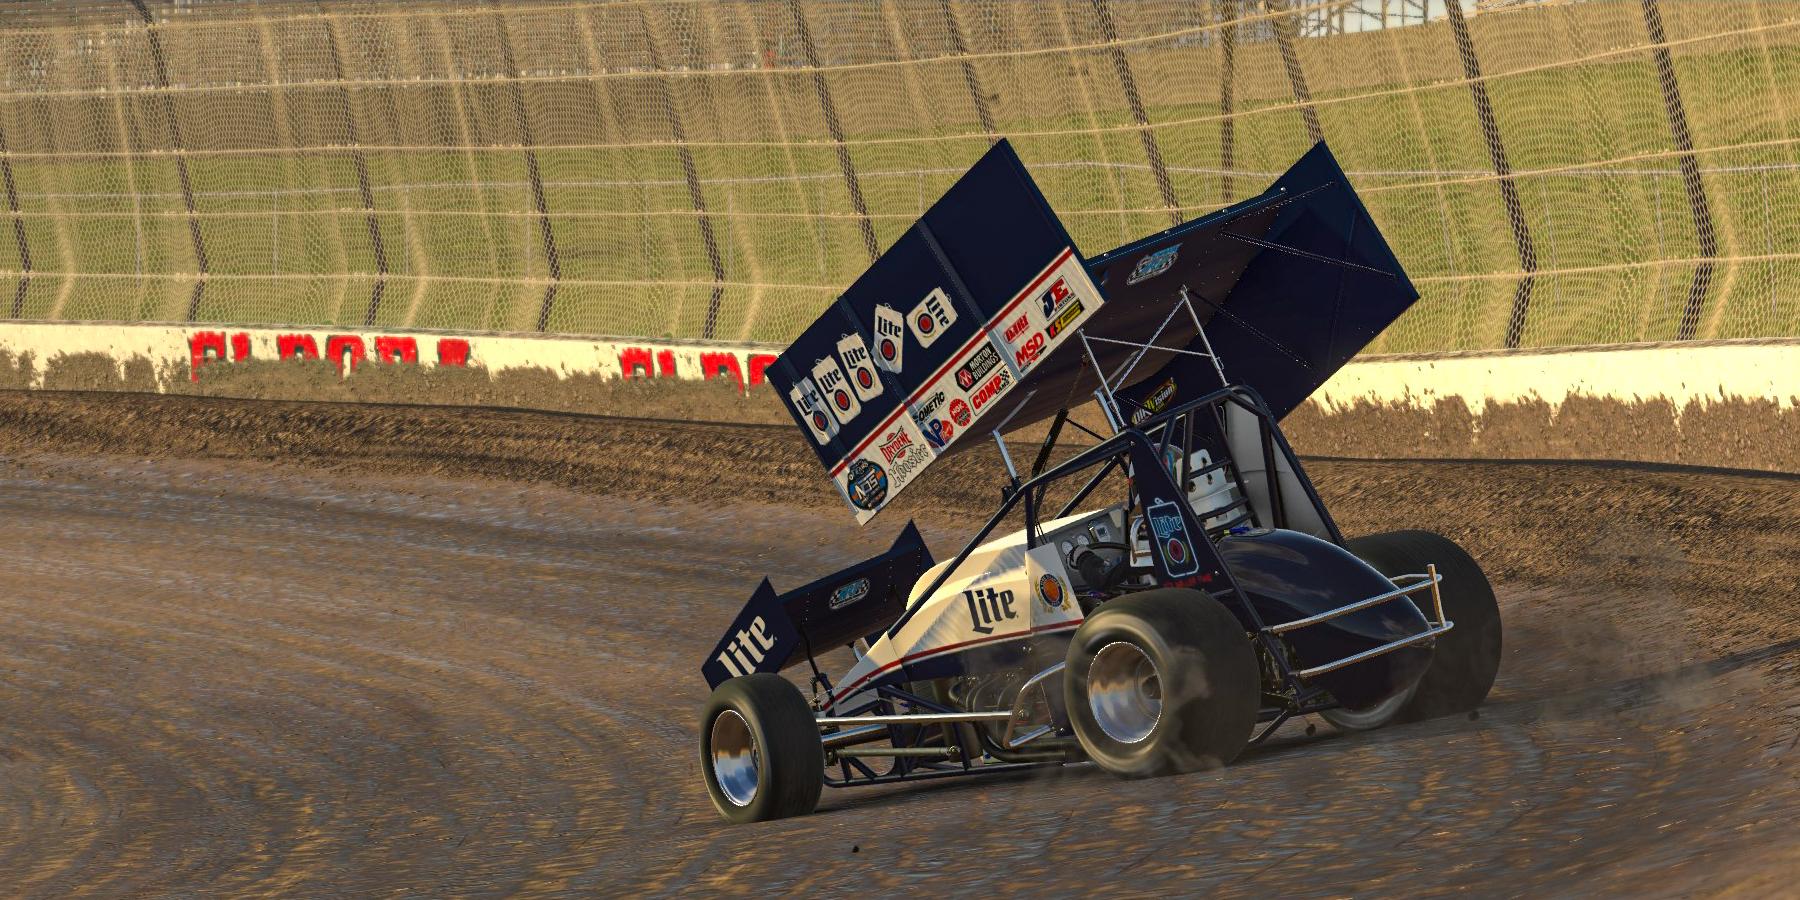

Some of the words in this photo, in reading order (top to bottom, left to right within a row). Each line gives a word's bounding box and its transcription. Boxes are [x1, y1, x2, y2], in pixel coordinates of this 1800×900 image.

[925, 295, 949, 327] Lite
[877, 316, 902, 338] Lite
[843, 346, 867, 369] Lite
[969, 346, 992, 371] MORTON
[1015, 331, 1045, 367] MSD
[972, 352, 999, 380] BUILDINGS
[819, 368, 842, 394] Lite
[972, 374, 1003, 410] COMP
[797, 389, 818, 416] Lite
[880, 431, 912, 464] DRYDENE
[1152, 515, 1182, 539] Lite
[962, 587, 1017, 634] Lite
